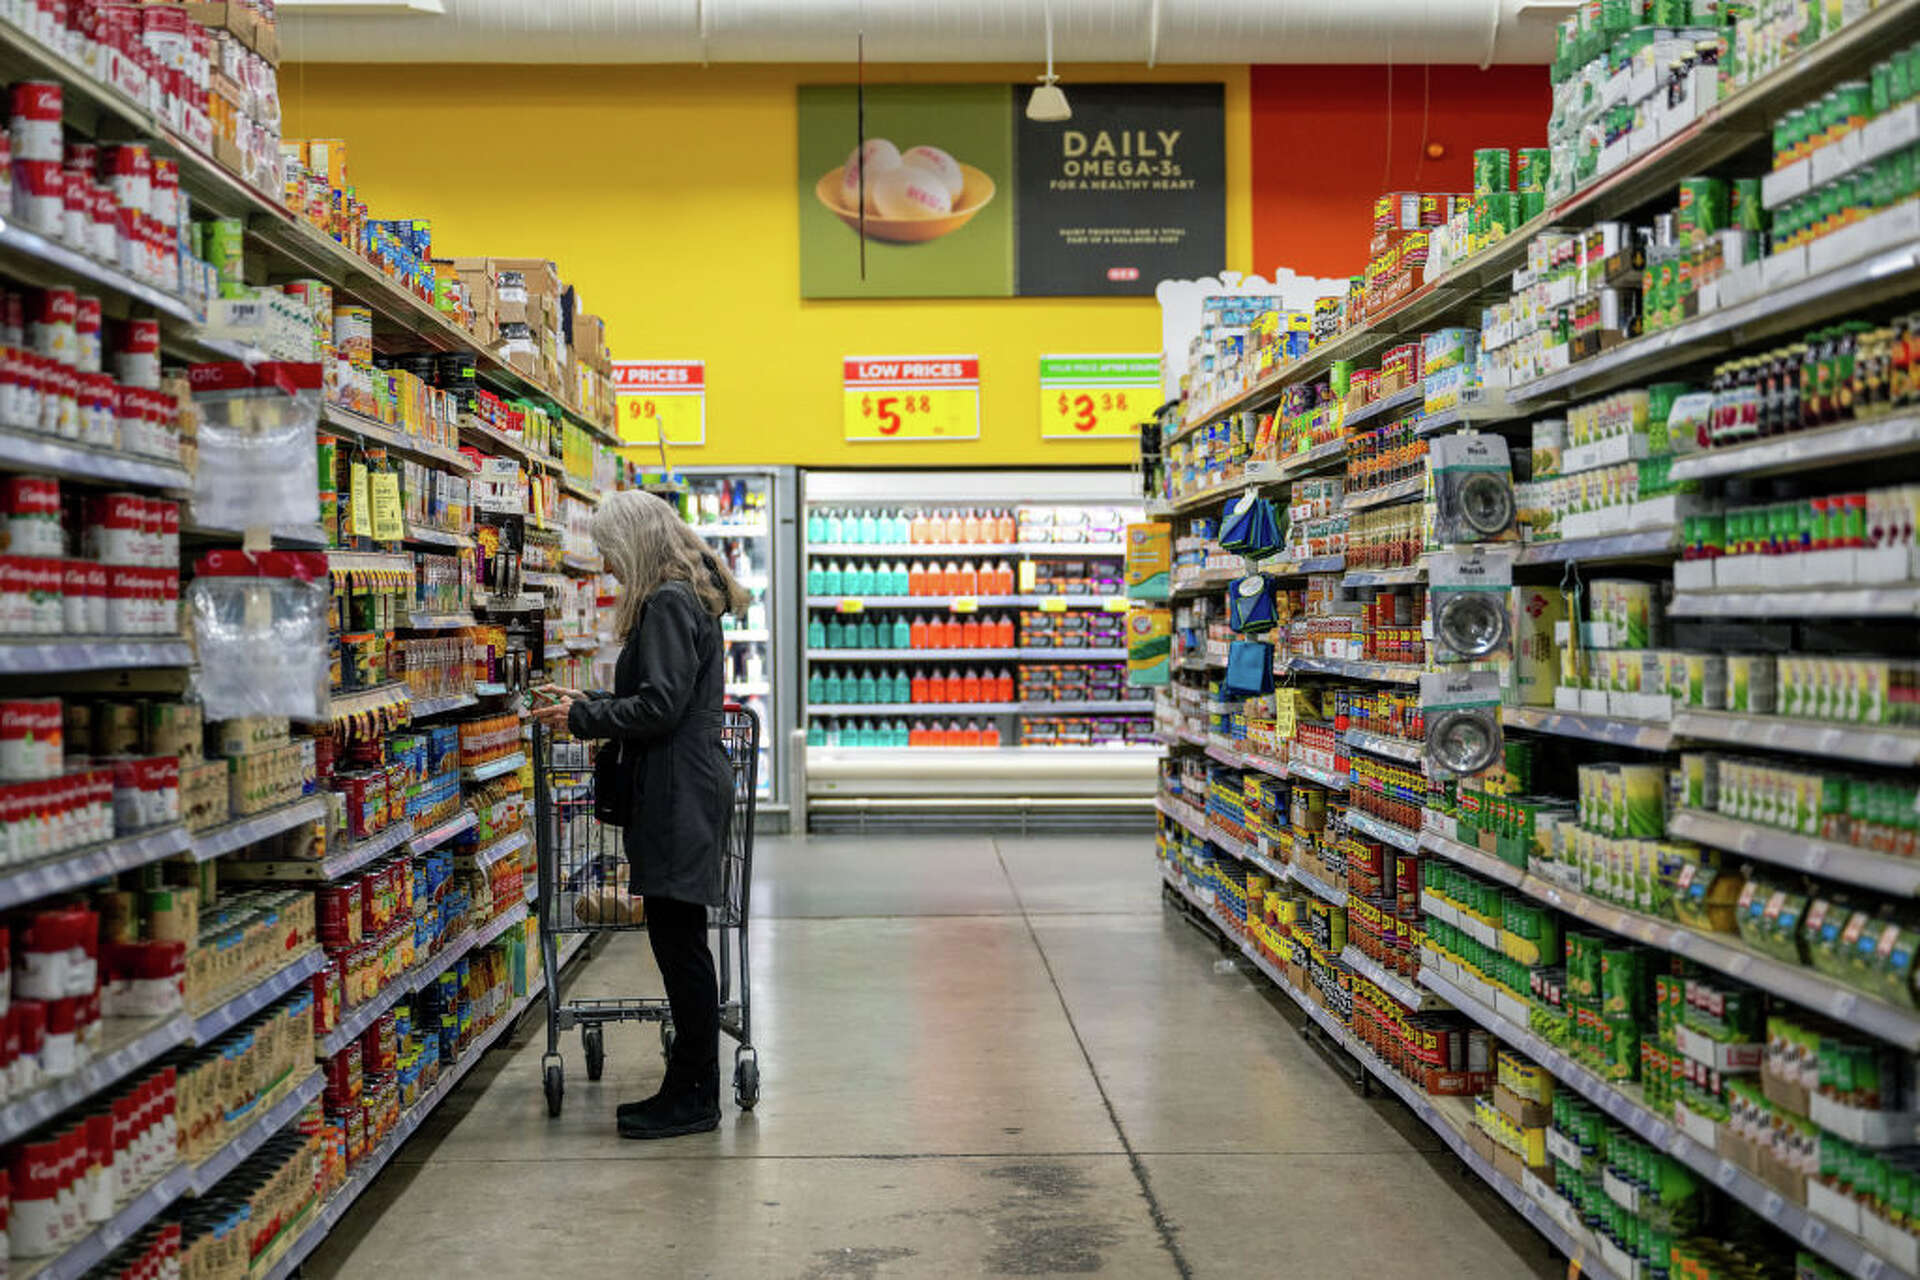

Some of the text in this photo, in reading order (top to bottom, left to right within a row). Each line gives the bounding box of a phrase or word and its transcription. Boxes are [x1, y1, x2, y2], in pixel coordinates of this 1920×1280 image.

[1063, 131, 1181, 157] DAILY
[1050, 180, 1196, 190] FOR A HEALTHY HEART
[628, 369, 688, 382] PRICES
[859, 363, 963, 377] LOW PRICES
